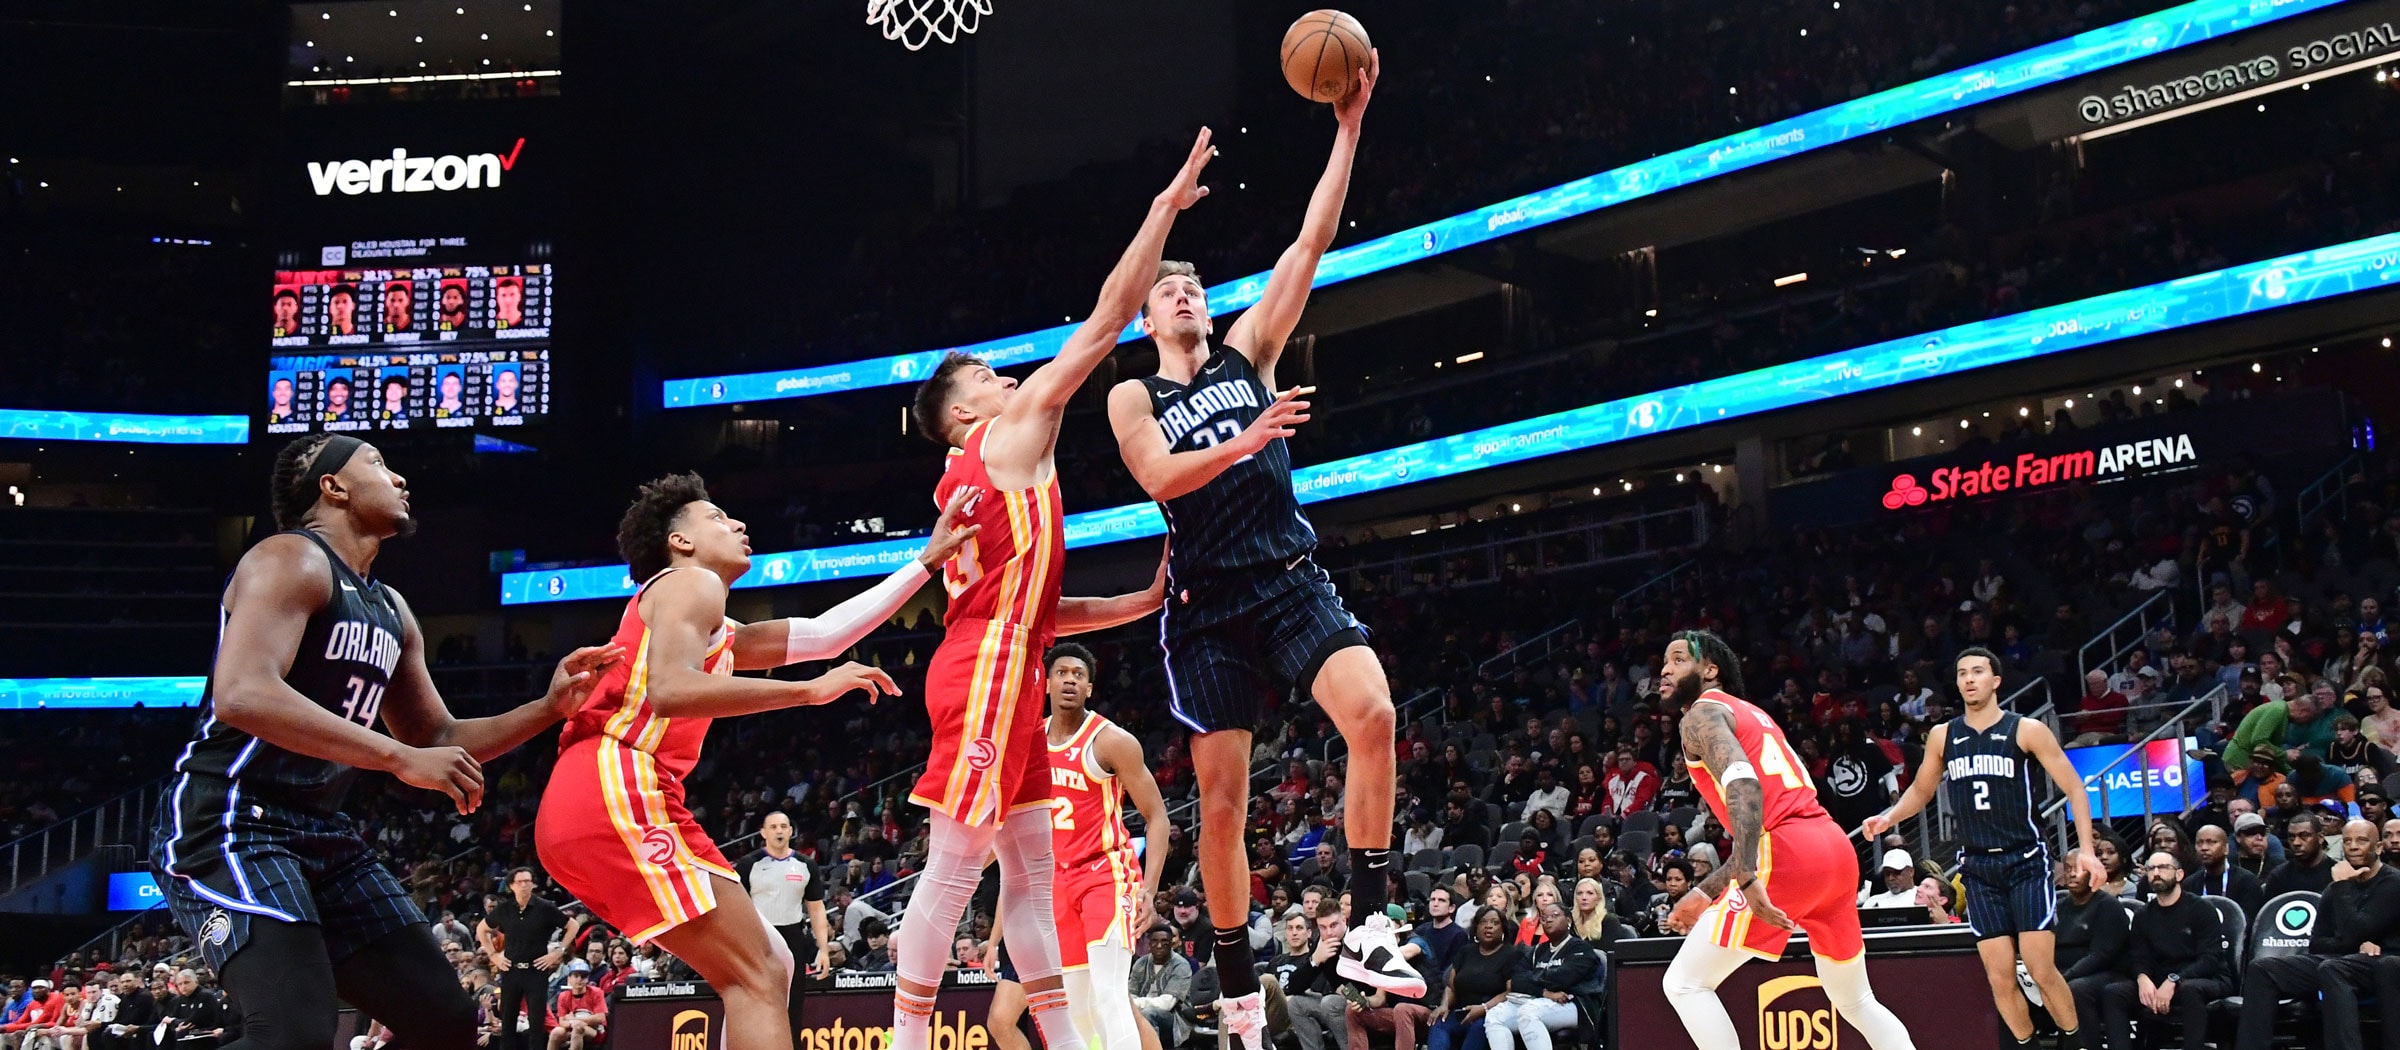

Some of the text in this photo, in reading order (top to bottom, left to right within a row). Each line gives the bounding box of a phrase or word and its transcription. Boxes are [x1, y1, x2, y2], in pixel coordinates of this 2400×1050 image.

[2112, 56, 2279, 117] sharecare
[2289, 22, 2400, 70] SOCIAL
[307, 147, 501, 195] verizon
[514, 264, 520, 276] 1
[322, 295, 329, 303] 4
[320, 326, 328, 335] 2
[510, 350, 518, 362] 2
[540, 350, 549, 360] 4
[776, 371, 852, 393] globalpayments
[485, 406, 492, 416] 2
[541, 404, 548, 414] 2
[1159, 379, 1259, 450] ORLANDO
[268, 422, 309, 433] HOUSTAN
[324, 421, 358, 431] CARTER
[1930, 433, 2196, 501] State Farm ARENA
[1314, 470, 1358, 488] deliver
[811, 554, 876, 570] Innovation
[878, 550, 903, 563] that
[342, 675, 386, 729] 34
[1948, 754, 2015, 781] ORLANDO
[1972, 780, 1991, 811] 2
[626, 982, 696, 997] hotels.com/Hawks
